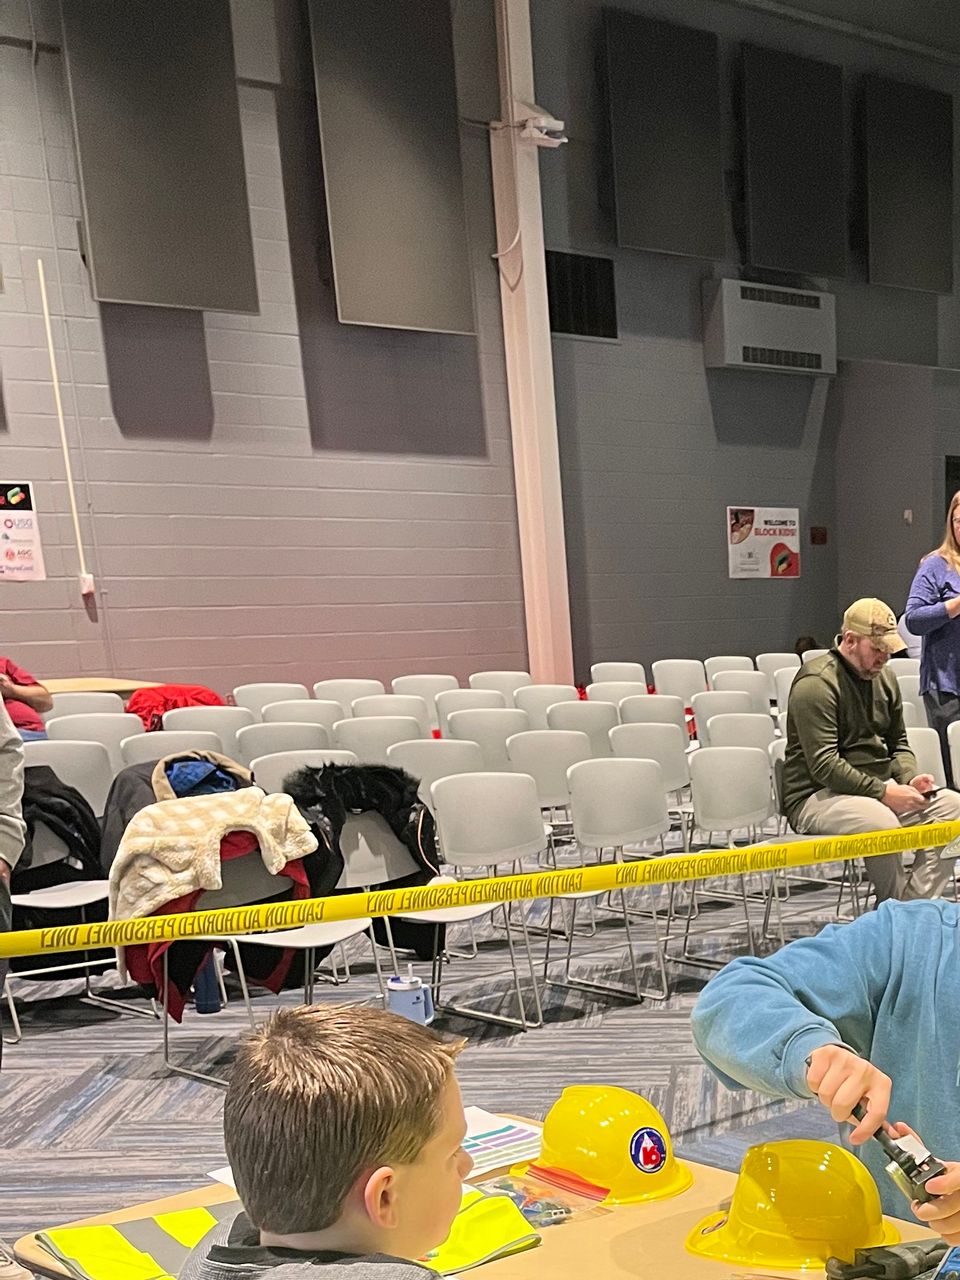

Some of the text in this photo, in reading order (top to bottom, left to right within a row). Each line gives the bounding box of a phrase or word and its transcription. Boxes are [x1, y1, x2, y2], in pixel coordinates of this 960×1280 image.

[763, 519, 788, 527] WELCOME
[754, 527, 797, 537] BLOCK KIDS!
